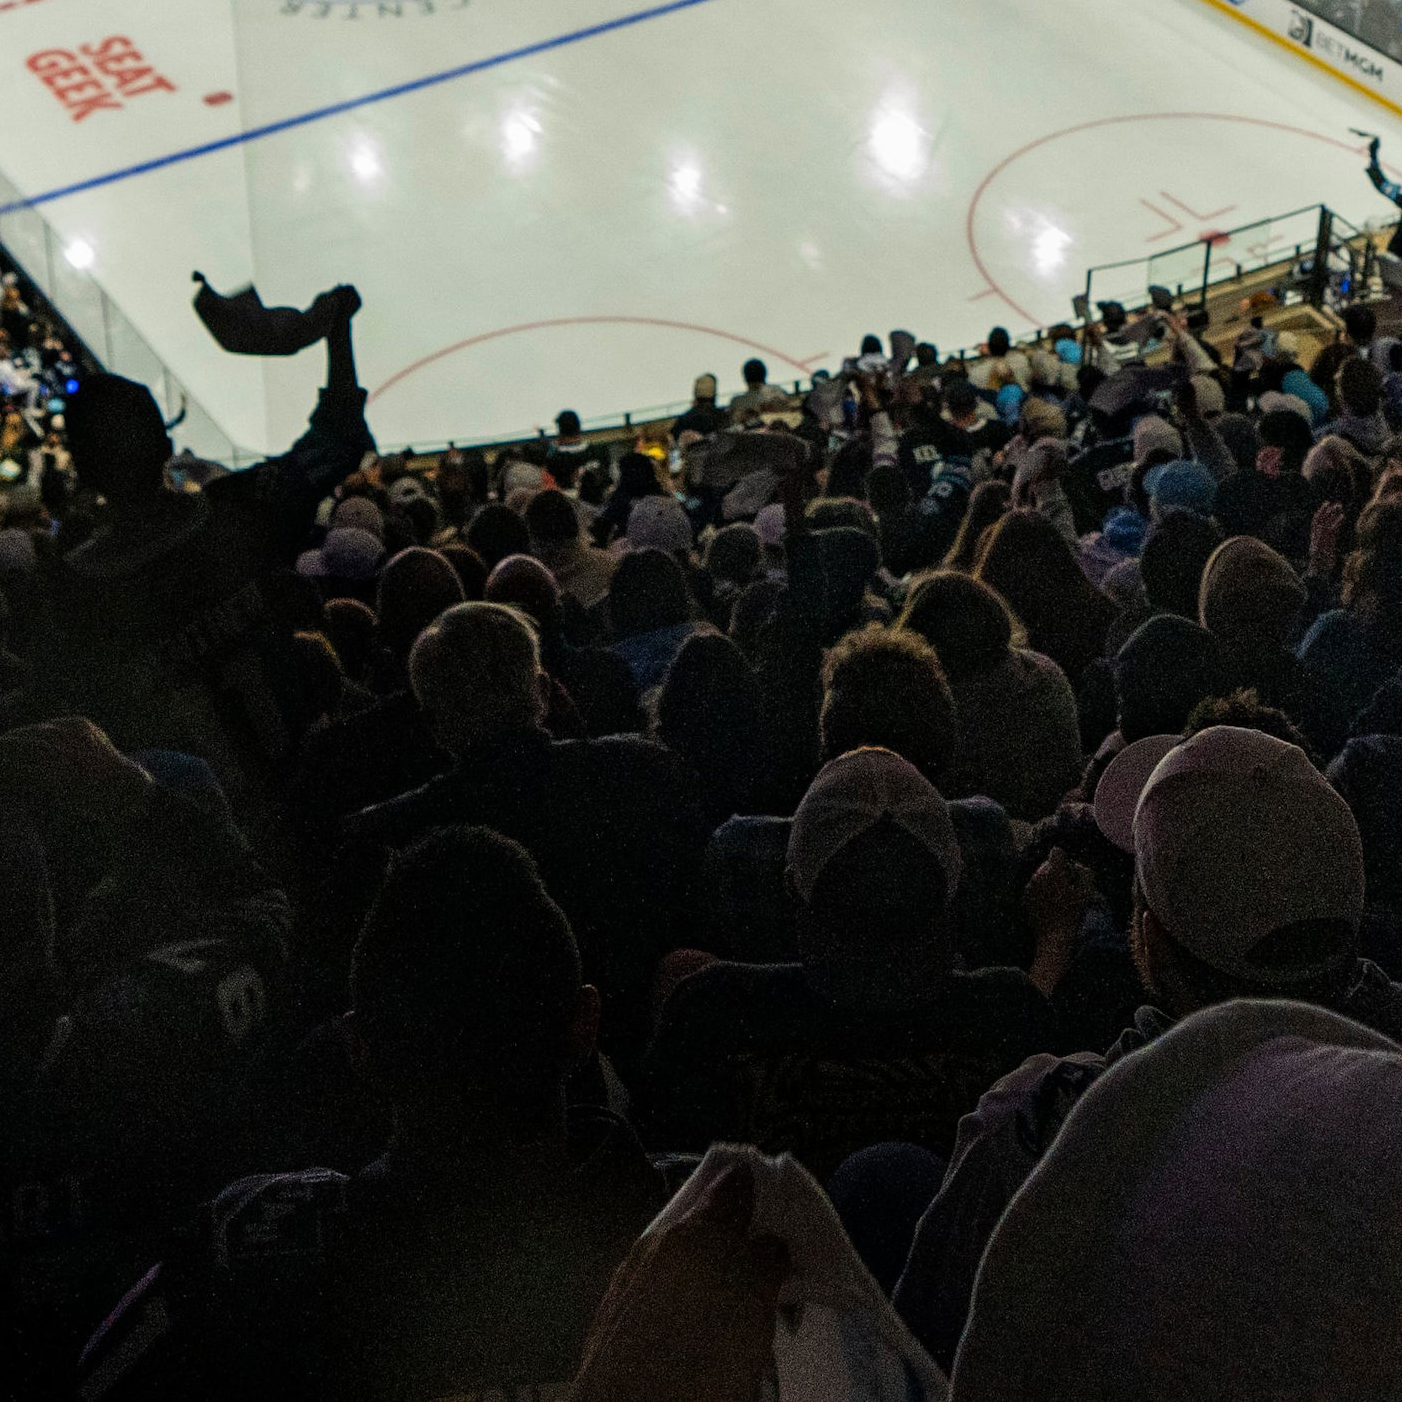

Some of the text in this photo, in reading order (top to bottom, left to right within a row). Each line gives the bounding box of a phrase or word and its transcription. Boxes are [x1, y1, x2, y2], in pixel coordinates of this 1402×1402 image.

[25, 47, 125, 123] GEEK
[81, 35, 181, 100] SEAT
[1316, 32, 1383, 81] BETMGM
